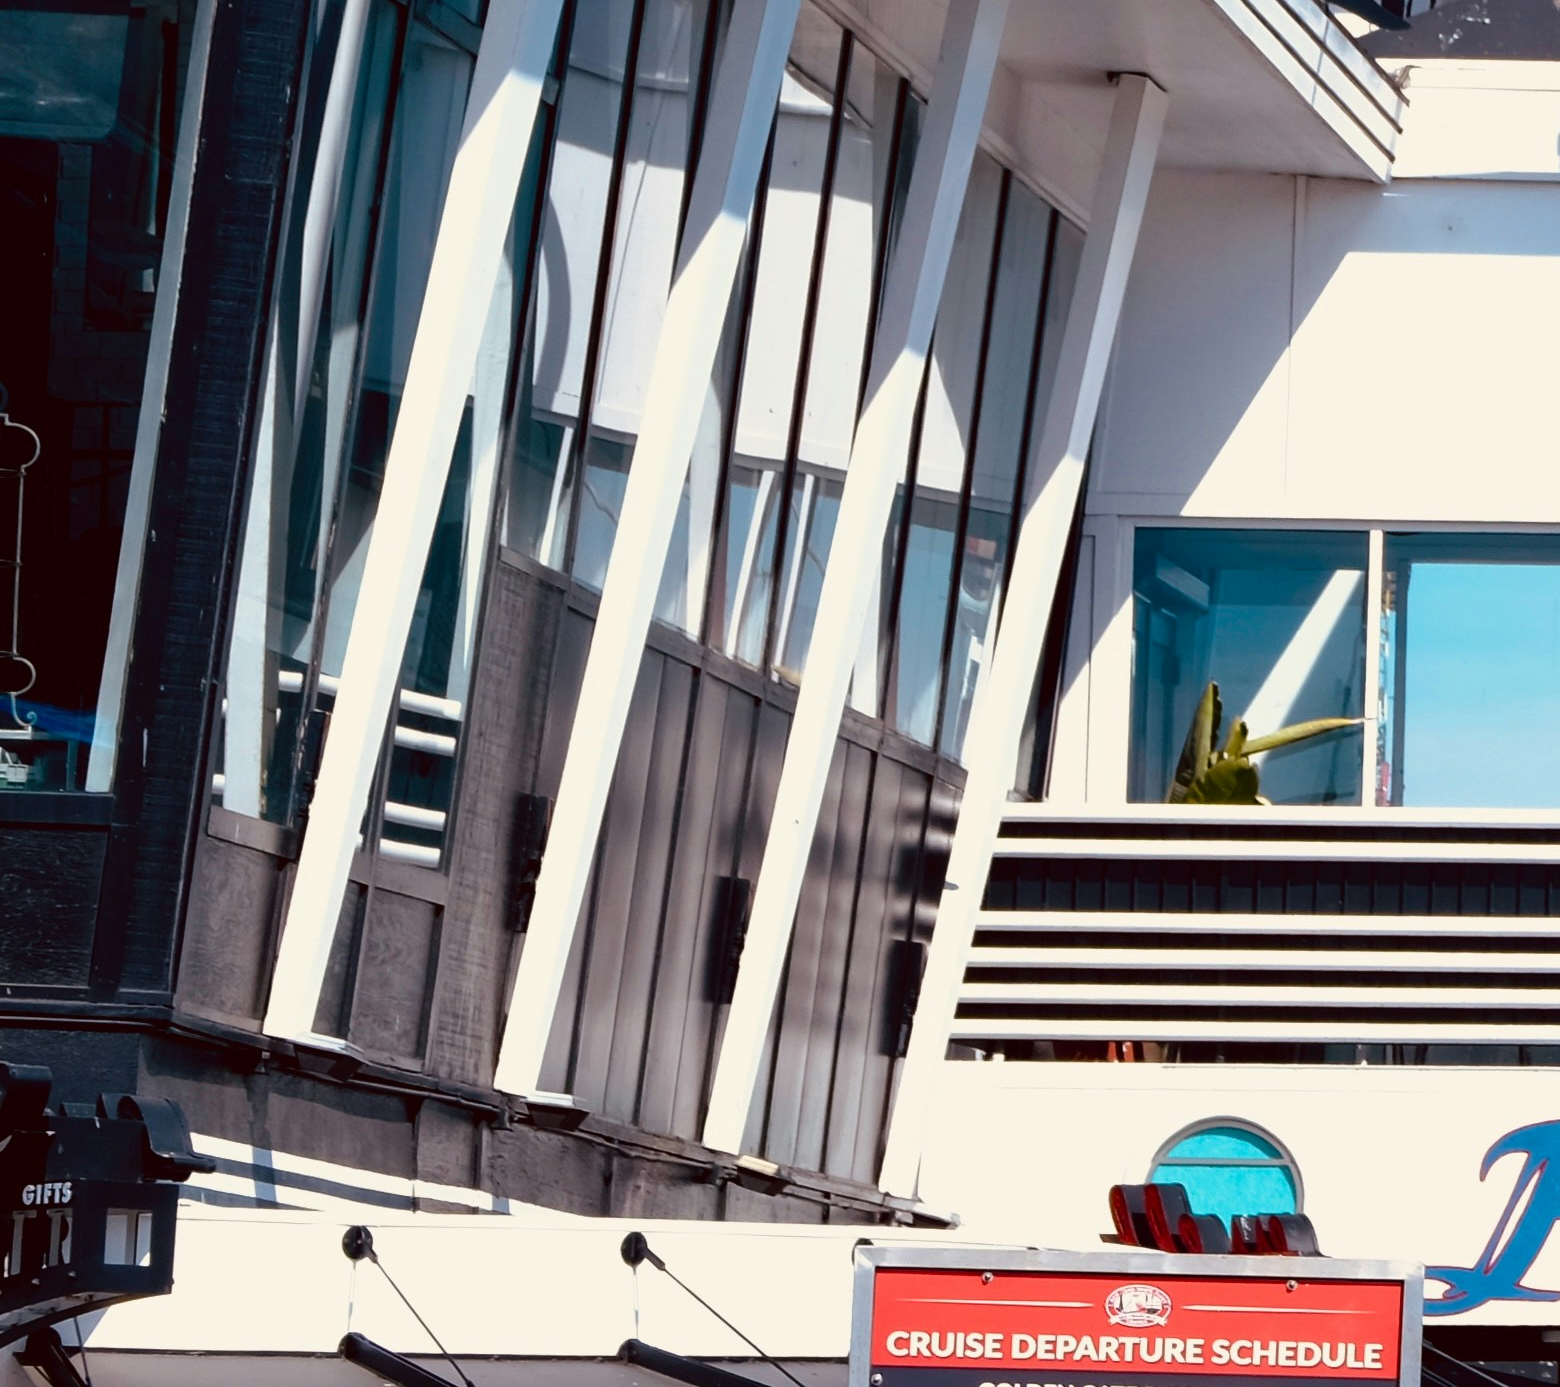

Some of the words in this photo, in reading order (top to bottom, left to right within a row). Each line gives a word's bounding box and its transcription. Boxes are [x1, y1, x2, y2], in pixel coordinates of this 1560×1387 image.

[21, 1181, 73, 1206] GIFTS
[886, 1330, 1004, 1360] CRUISE
[1011, 1333, 1204, 1365] DEPARTURE
[1211, 1338, 1384, 1370] SCHEDULE
